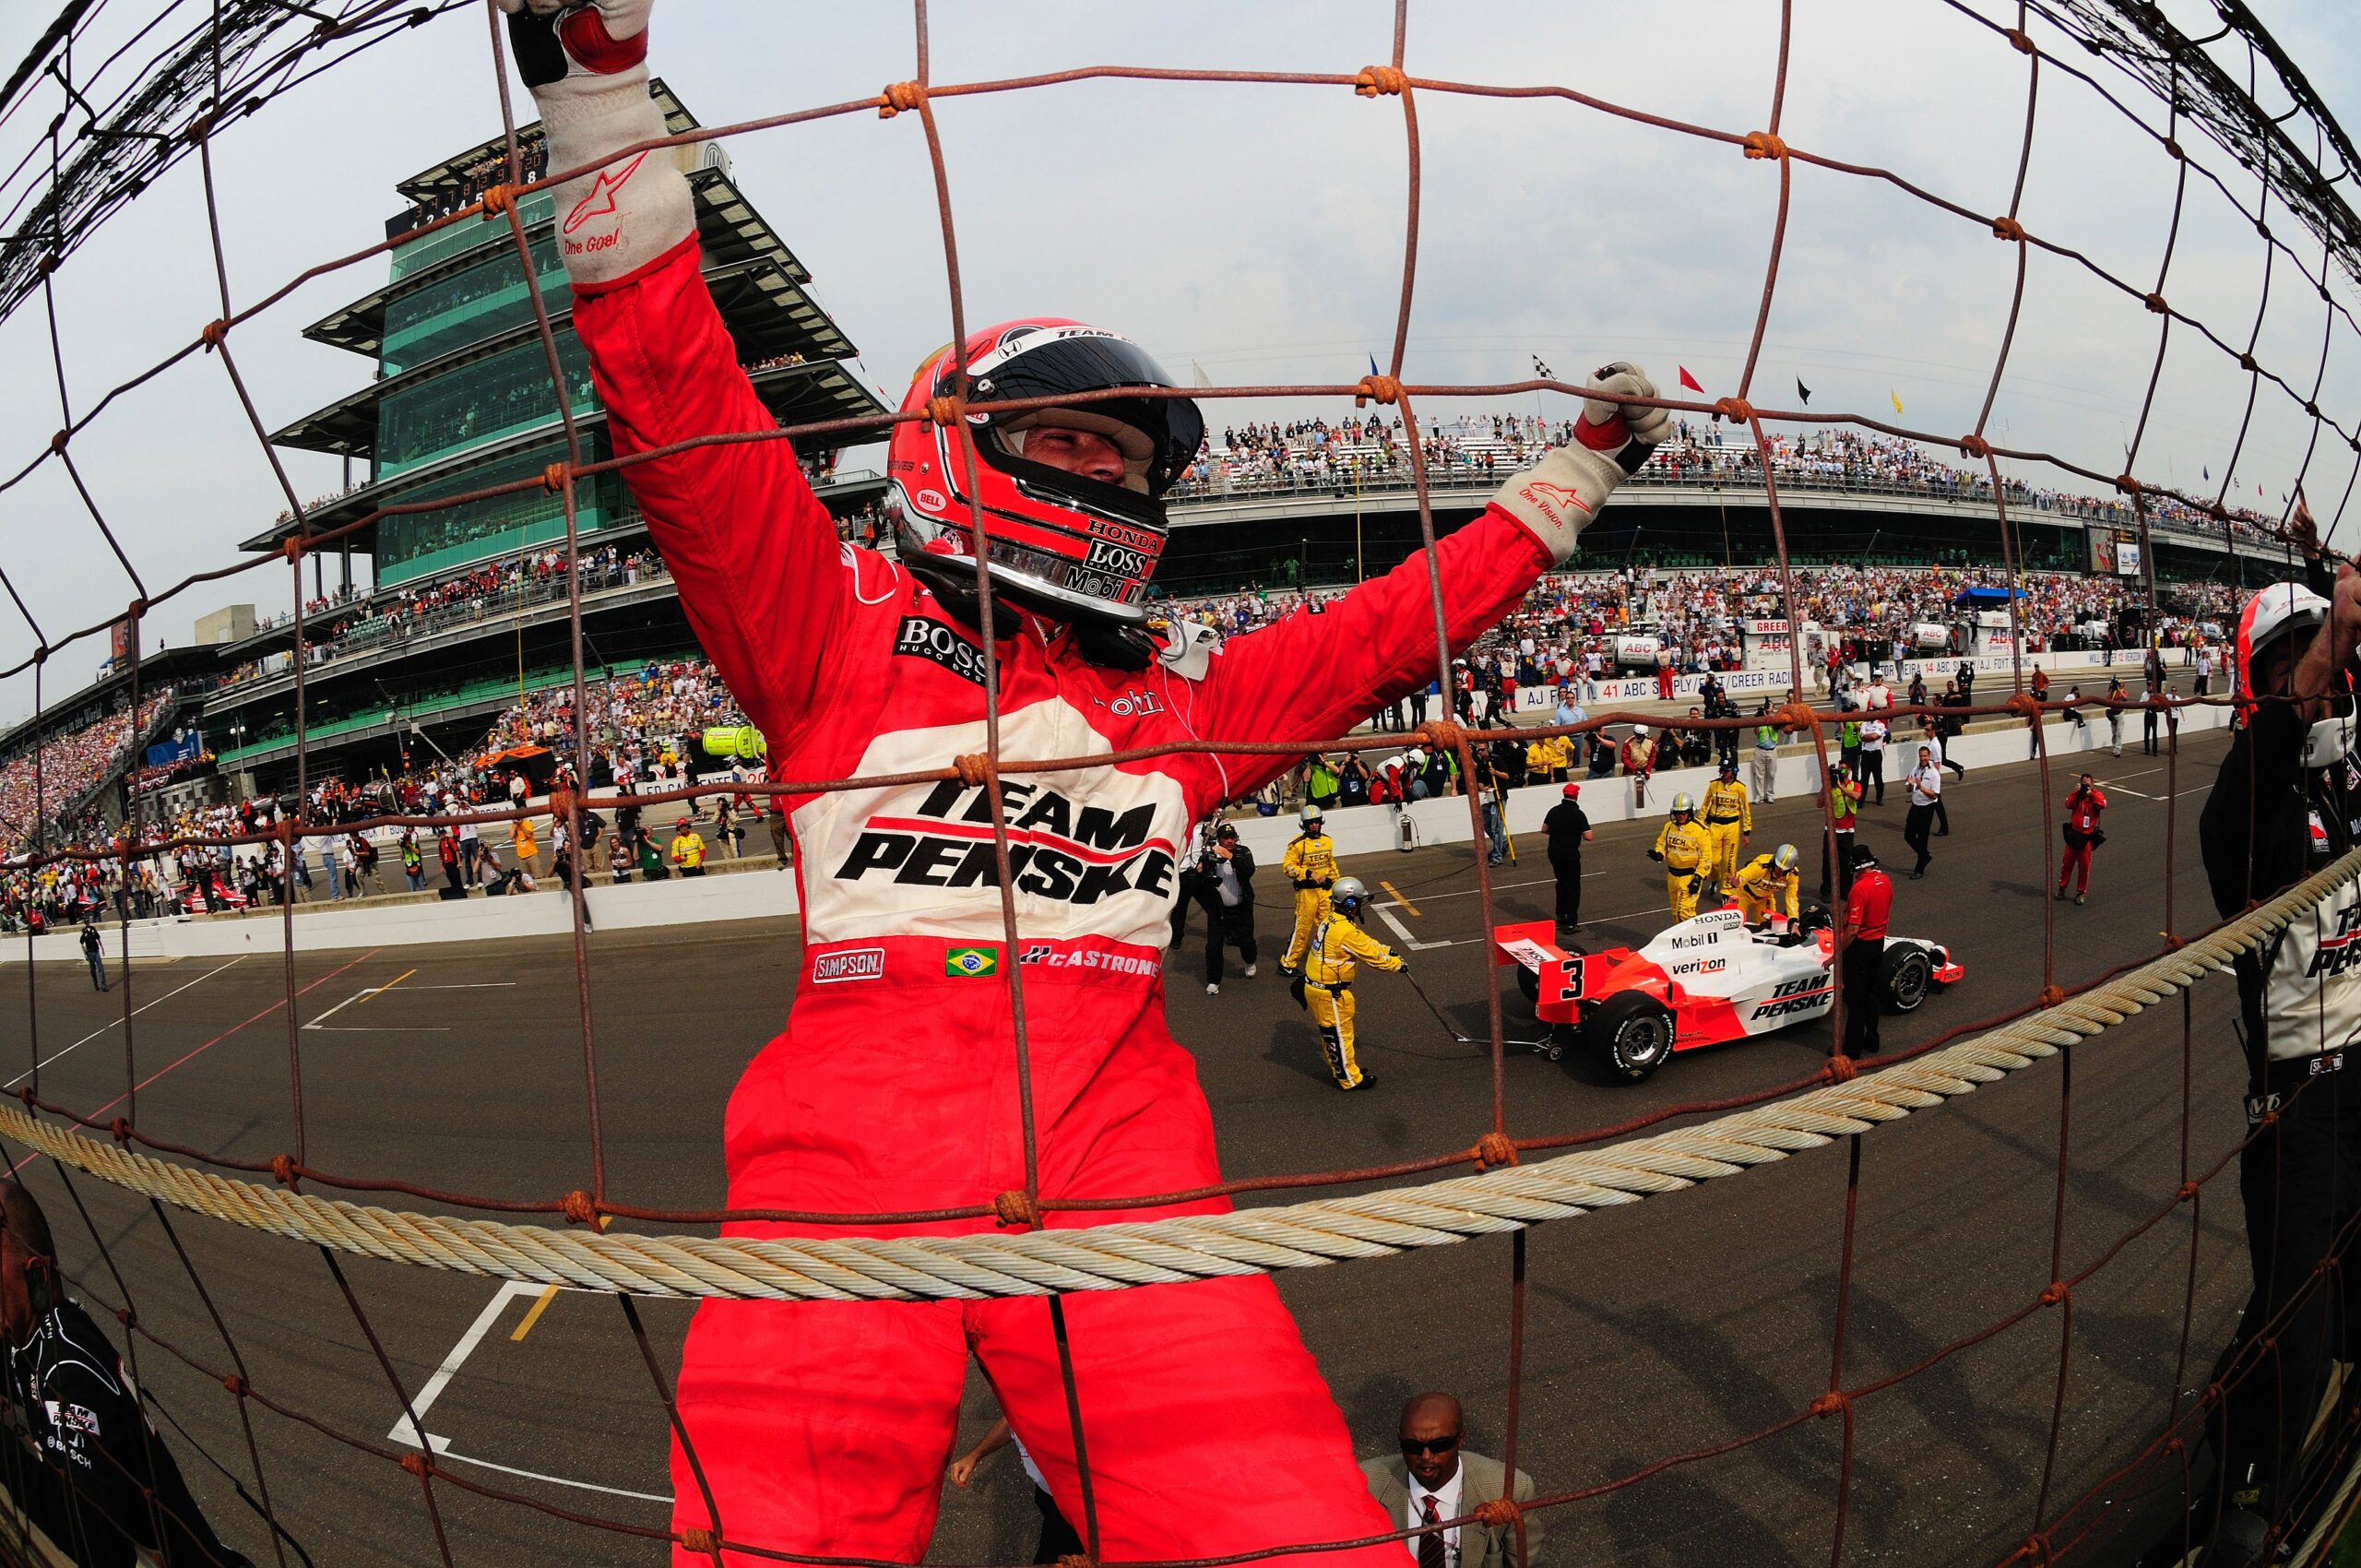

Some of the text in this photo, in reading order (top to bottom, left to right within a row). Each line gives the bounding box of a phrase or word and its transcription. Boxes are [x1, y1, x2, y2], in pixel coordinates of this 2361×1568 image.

[528, 171, 536, 184] 8
[458, 199, 467, 211] 4
[476, 192, 483, 204] 5
[427, 214, 434, 224] 2
[443, 208, 450, 218] 3
[564, 228, 619, 255] One Goal
[1057, 329, 1114, 339] TEAM
[920, 493, 941, 506] BELL
[1519, 488, 1537, 503] One
[1087, 518, 1158, 552] HONDA
[1091, 542, 1145, 574] BOSS
[1757, 622, 1787, 632] GREER
[1624, 643, 1652, 653] ABC
[899, 645, 982, 683] HUGO BOS
[1925, 661, 1934, 673] 14
[1937, 660, 1951, 673] ABC
[1527, 690, 1544, 706] AJ
[1603, 684, 1619, 698] 41
[1624, 682, 1646, 697] ABC
[1717, 796, 1736, 804] TECH
[917, 778, 1157, 851] TEAM
[1668, 837, 1686, 846] TECH
[1309, 853, 1329, 862] TECH
[834, 831, 1176, 905] PENSKE
[1694, 912, 1740, 924] HONDA
[1671, 932, 1717, 949] Mobil 1
[817, 953, 881, 978] SIMPSON
[1672, 958, 1726, 974] verizon
[1560, 957, 1584, 1001] 3
[1772, 973, 1831, 998] TEAM
[1750, 991, 1833, 1020] PENSKE
